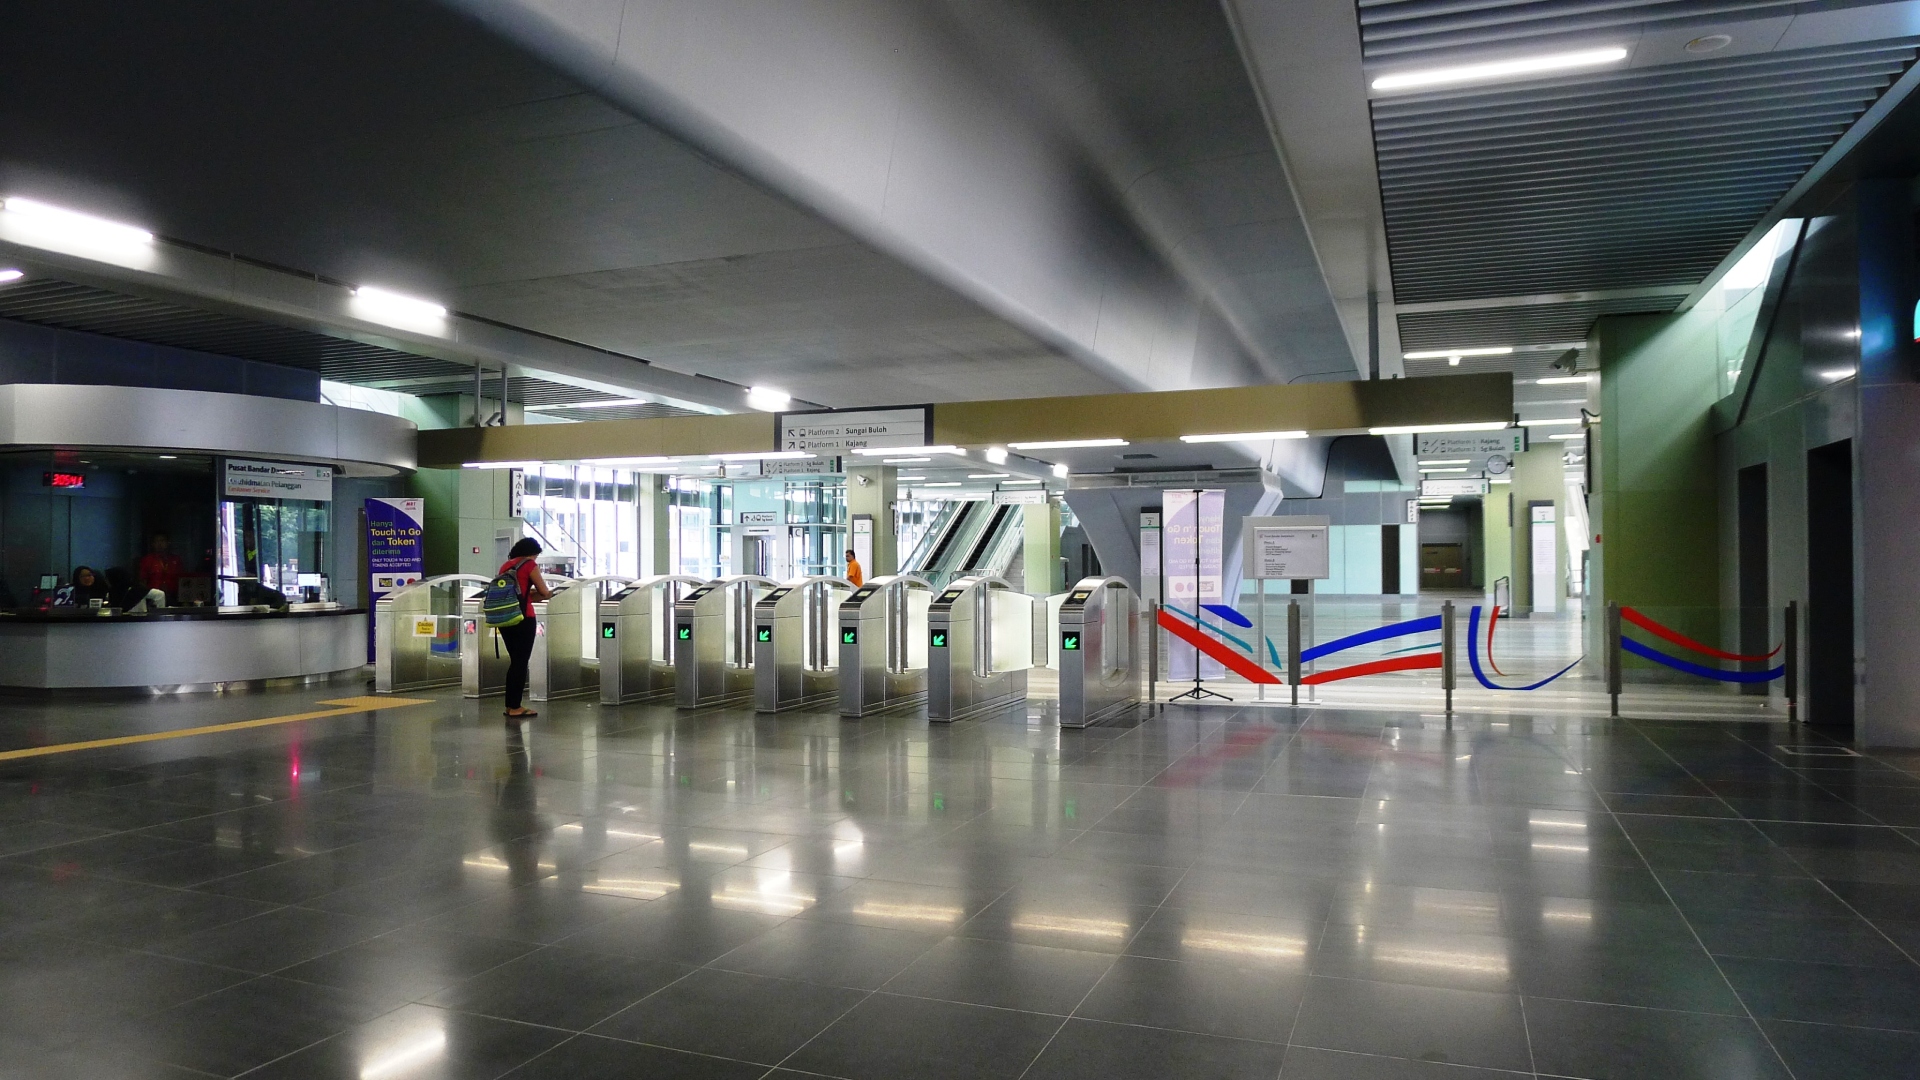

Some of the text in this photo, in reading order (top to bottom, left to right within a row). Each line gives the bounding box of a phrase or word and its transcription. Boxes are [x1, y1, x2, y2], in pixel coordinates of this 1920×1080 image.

[846, 427, 867, 436] Sungai
[228, 464, 246, 472] Pusat
[248, 465, 270, 473] Bandar
[387, 538, 415, 546] Token
